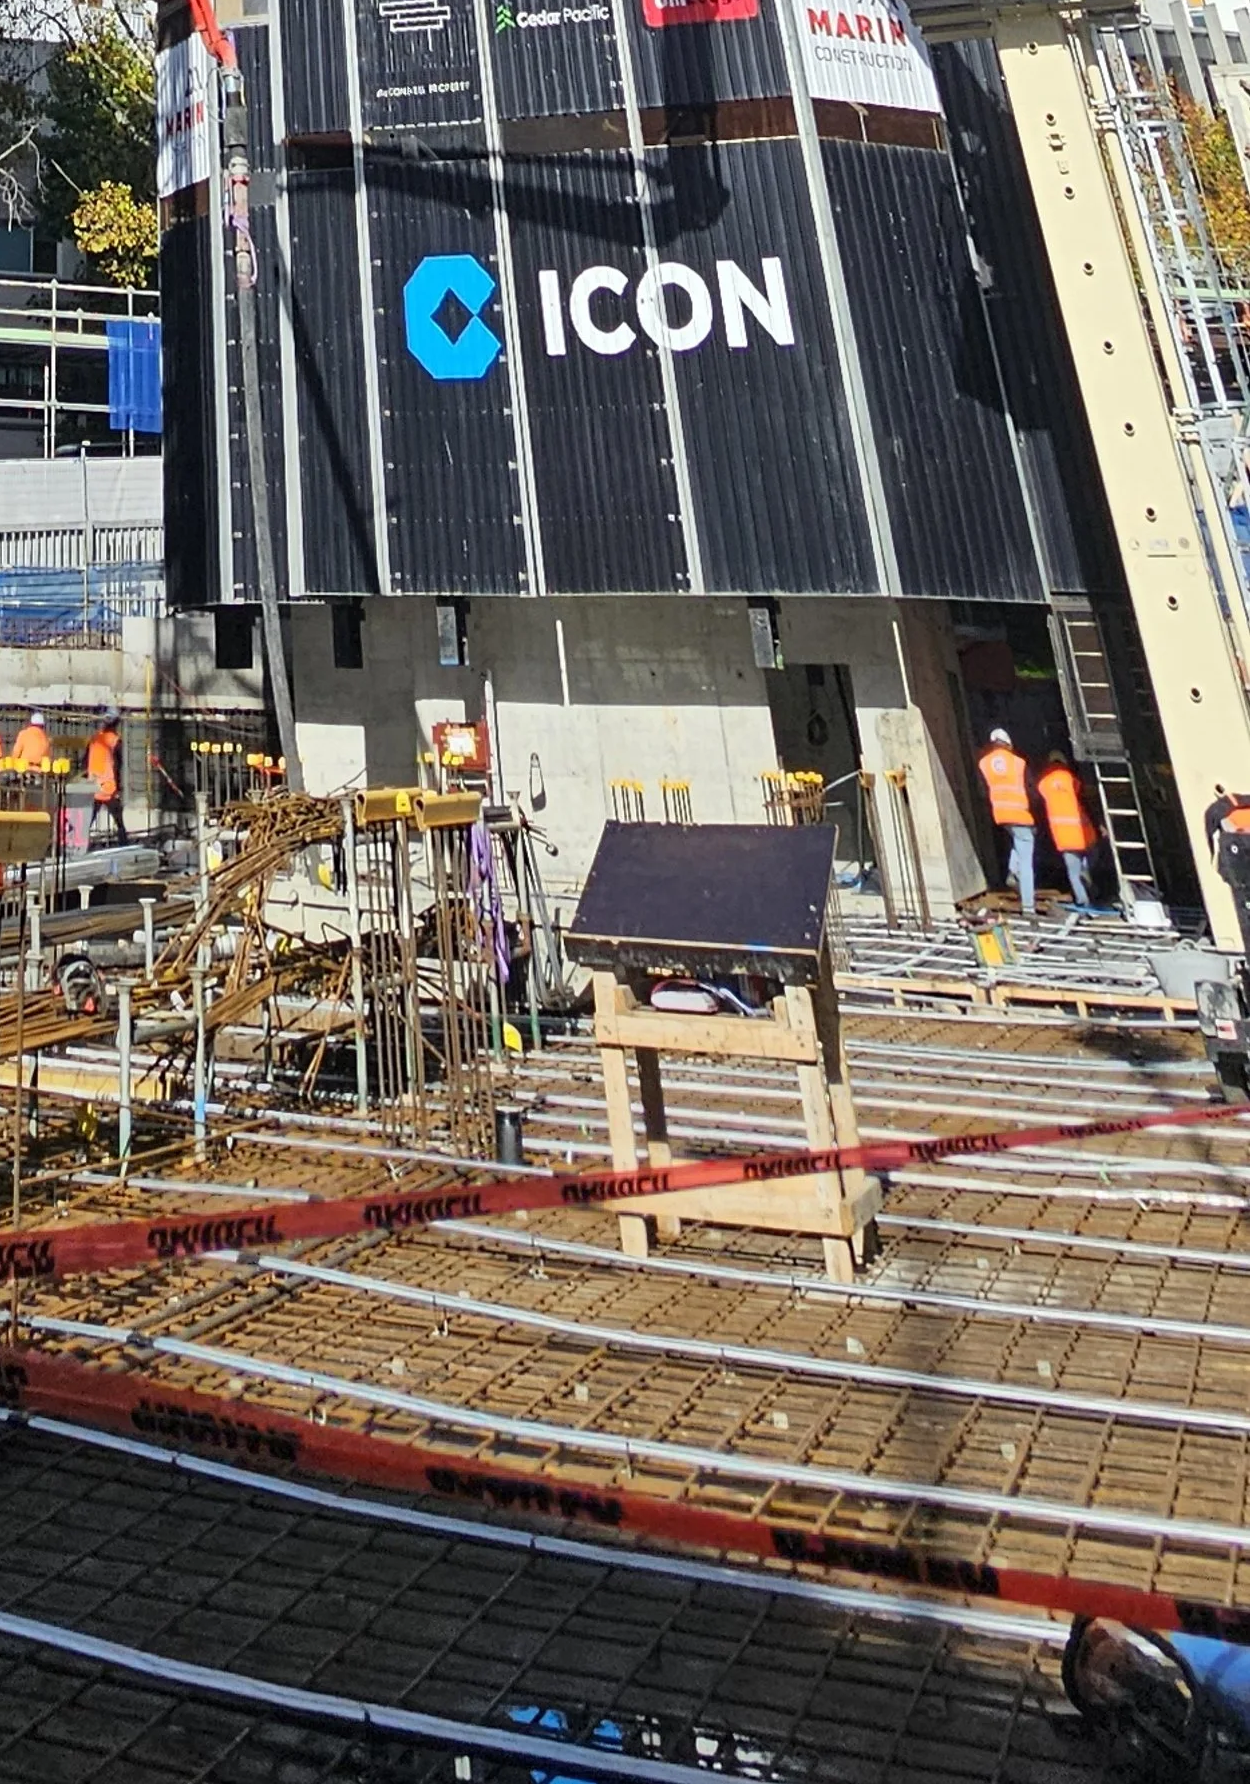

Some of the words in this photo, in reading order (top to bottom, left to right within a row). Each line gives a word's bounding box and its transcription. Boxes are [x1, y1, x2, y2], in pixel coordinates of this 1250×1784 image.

[516, 9, 561, 29] Cedar
[563, 4, 611, 23] Pacific
[807, 7, 907, 47] MARIN
[814, 45, 913, 72] CONSTRUCTION
[538, 256, 795, 357] ICON
